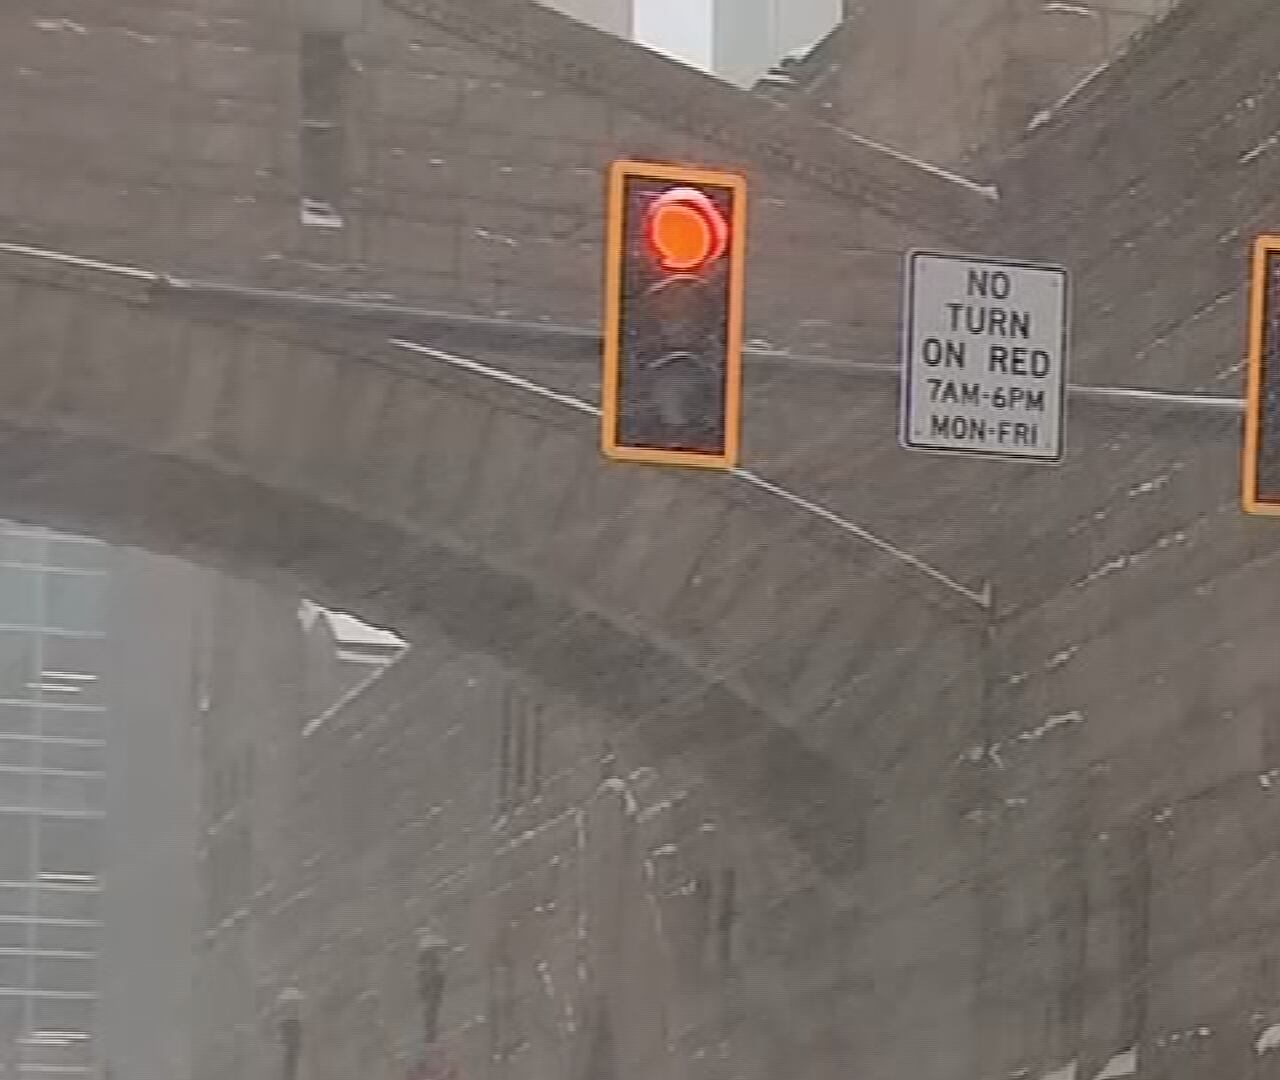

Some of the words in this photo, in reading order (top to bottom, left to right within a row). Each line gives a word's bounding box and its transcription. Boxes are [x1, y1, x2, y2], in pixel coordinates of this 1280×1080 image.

[967, 269, 1010, 300] NO
[946, 302, 1030, 339] TURN
[922, 337, 965, 368] ON
[989, 345, 1050, 379] RED
[927, 378, 1045, 412] 7AM-6PM
[930, 414, 1038, 446] MON-FRI
